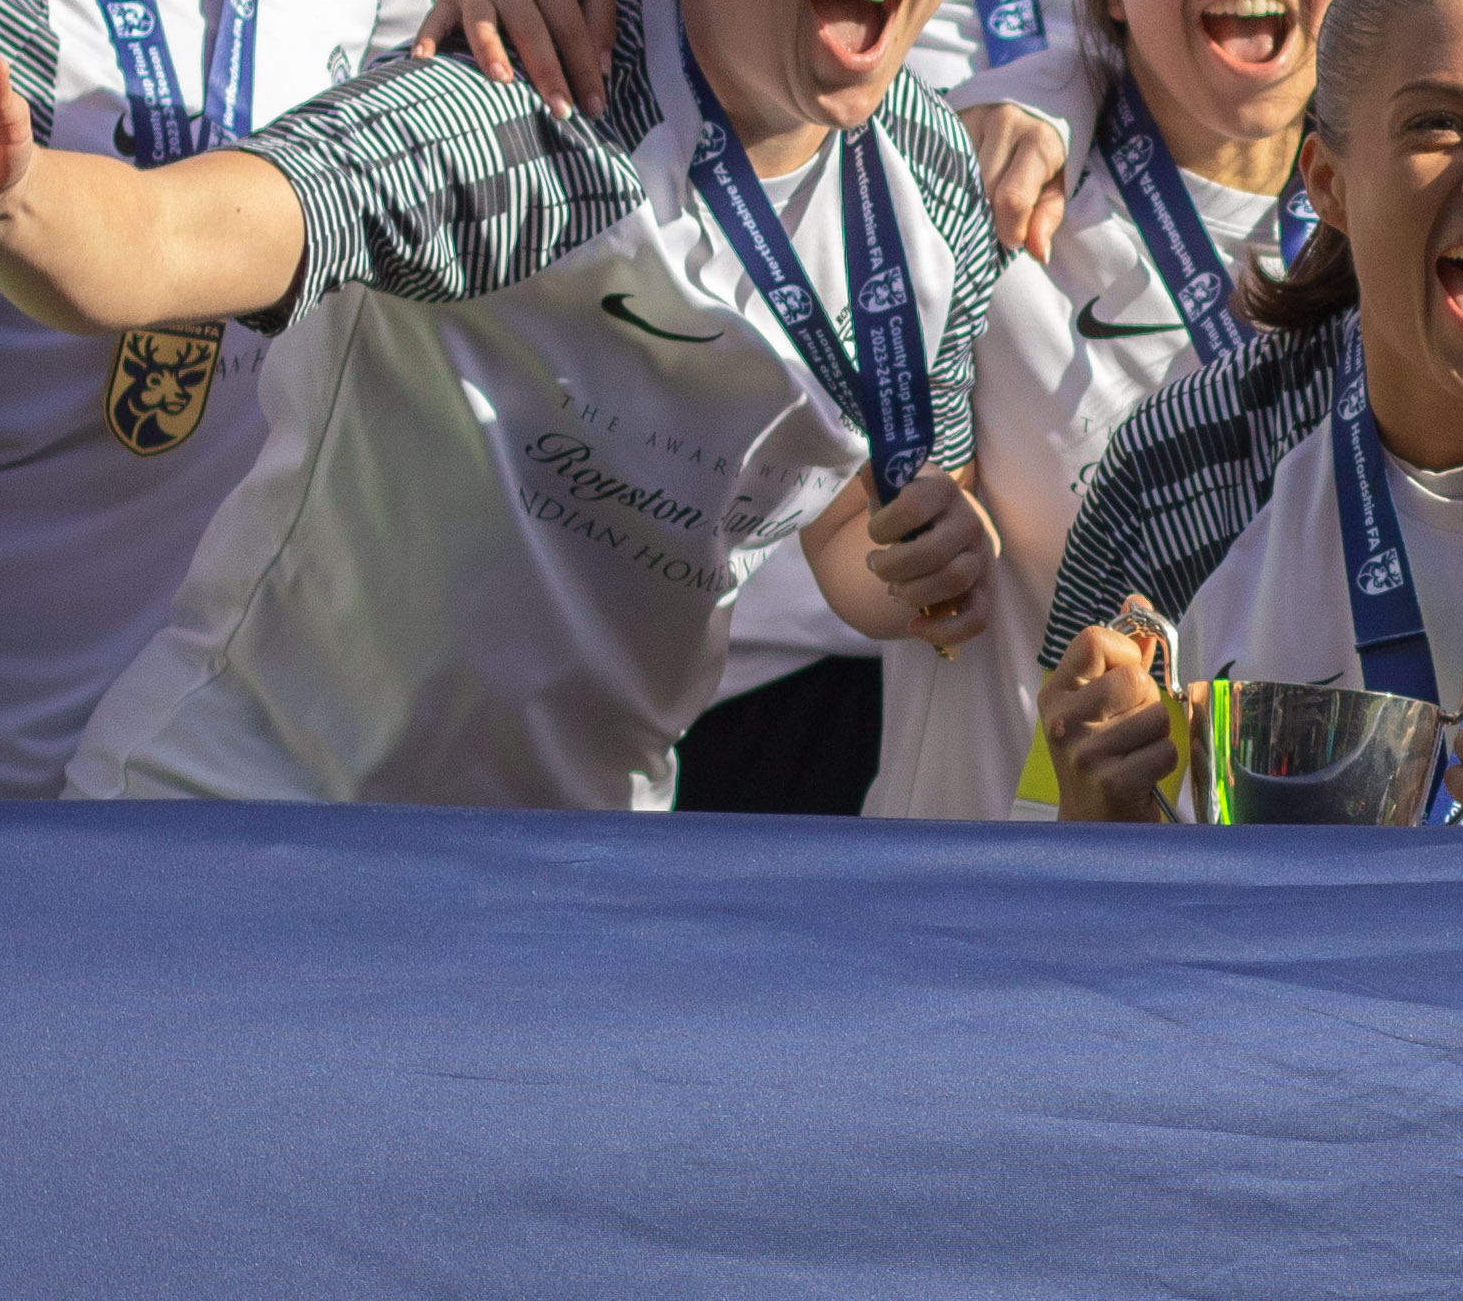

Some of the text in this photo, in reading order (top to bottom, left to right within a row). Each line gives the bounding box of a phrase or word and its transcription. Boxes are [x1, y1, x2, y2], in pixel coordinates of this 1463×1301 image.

[128, 42, 167, 162] County Cup Final
[149, 46, 171, 98] Season
[712, 160, 786, 283] Hertfordshire FA
[854, 144, 885, 272] Hertfordshire FA
[1139, 170, 1198, 277] Hertfordshire FA
[888, 315, 921, 443] County Cup Final
[1200, 316, 1223, 350] Final
[1219, 307, 1242, 346] eason
[870, 328, 896, 443] 2023-24 Season
[524, 433, 709, 533] Royston
[561, 394, 842, 493] THE AWAR WINNI
[1350, 421, 1381, 551] Hertfordshire FA
[519, 487, 628, 550] NDIAN
